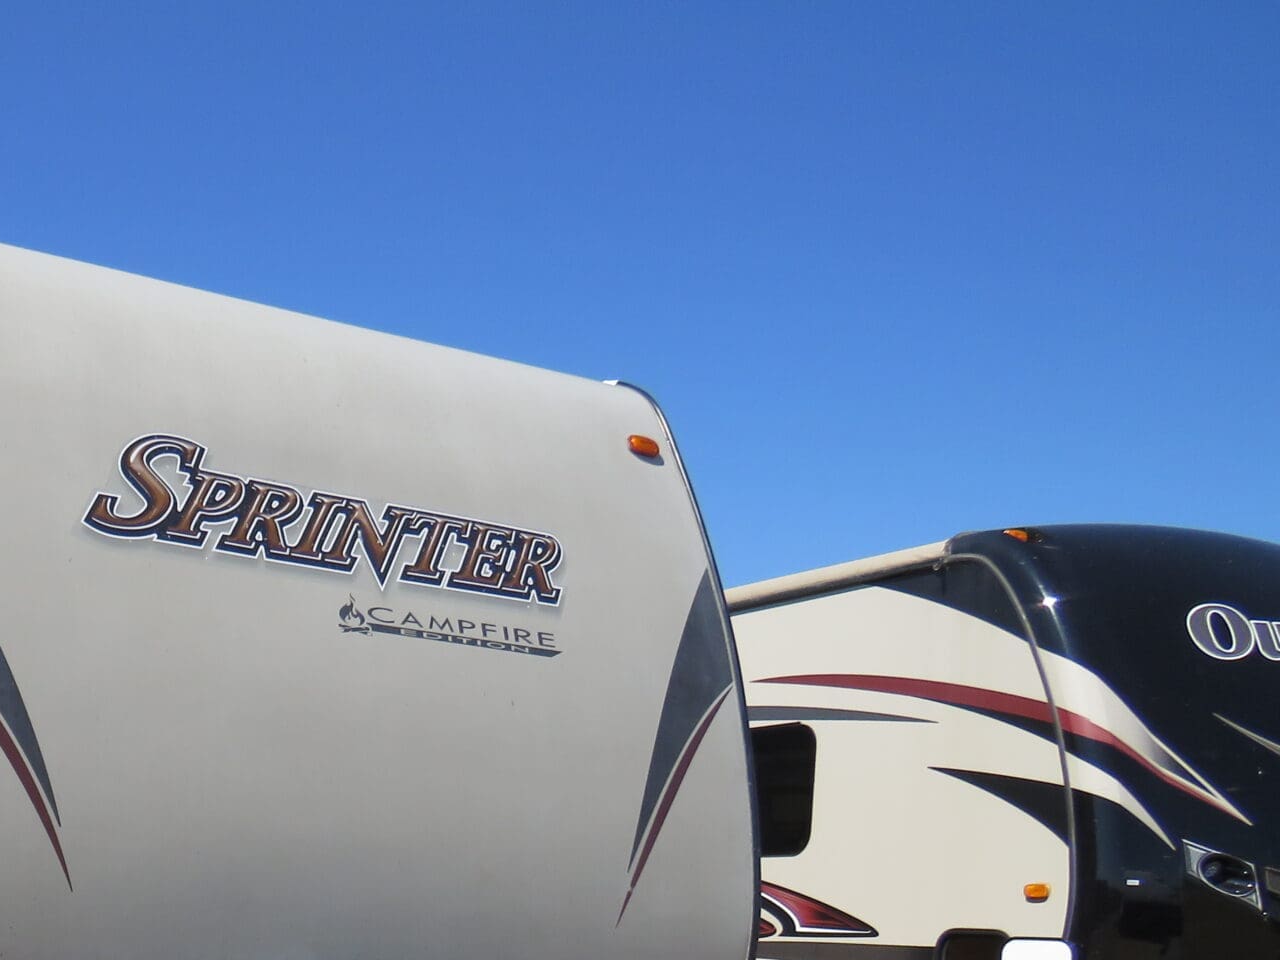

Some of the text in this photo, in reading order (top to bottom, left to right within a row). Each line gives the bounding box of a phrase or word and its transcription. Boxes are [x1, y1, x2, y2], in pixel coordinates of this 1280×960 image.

[82, 433, 563, 606] SPRINTER
[367, 607, 557, 649] CAMPFIRE
[400, 628, 530, 654] EDITION
